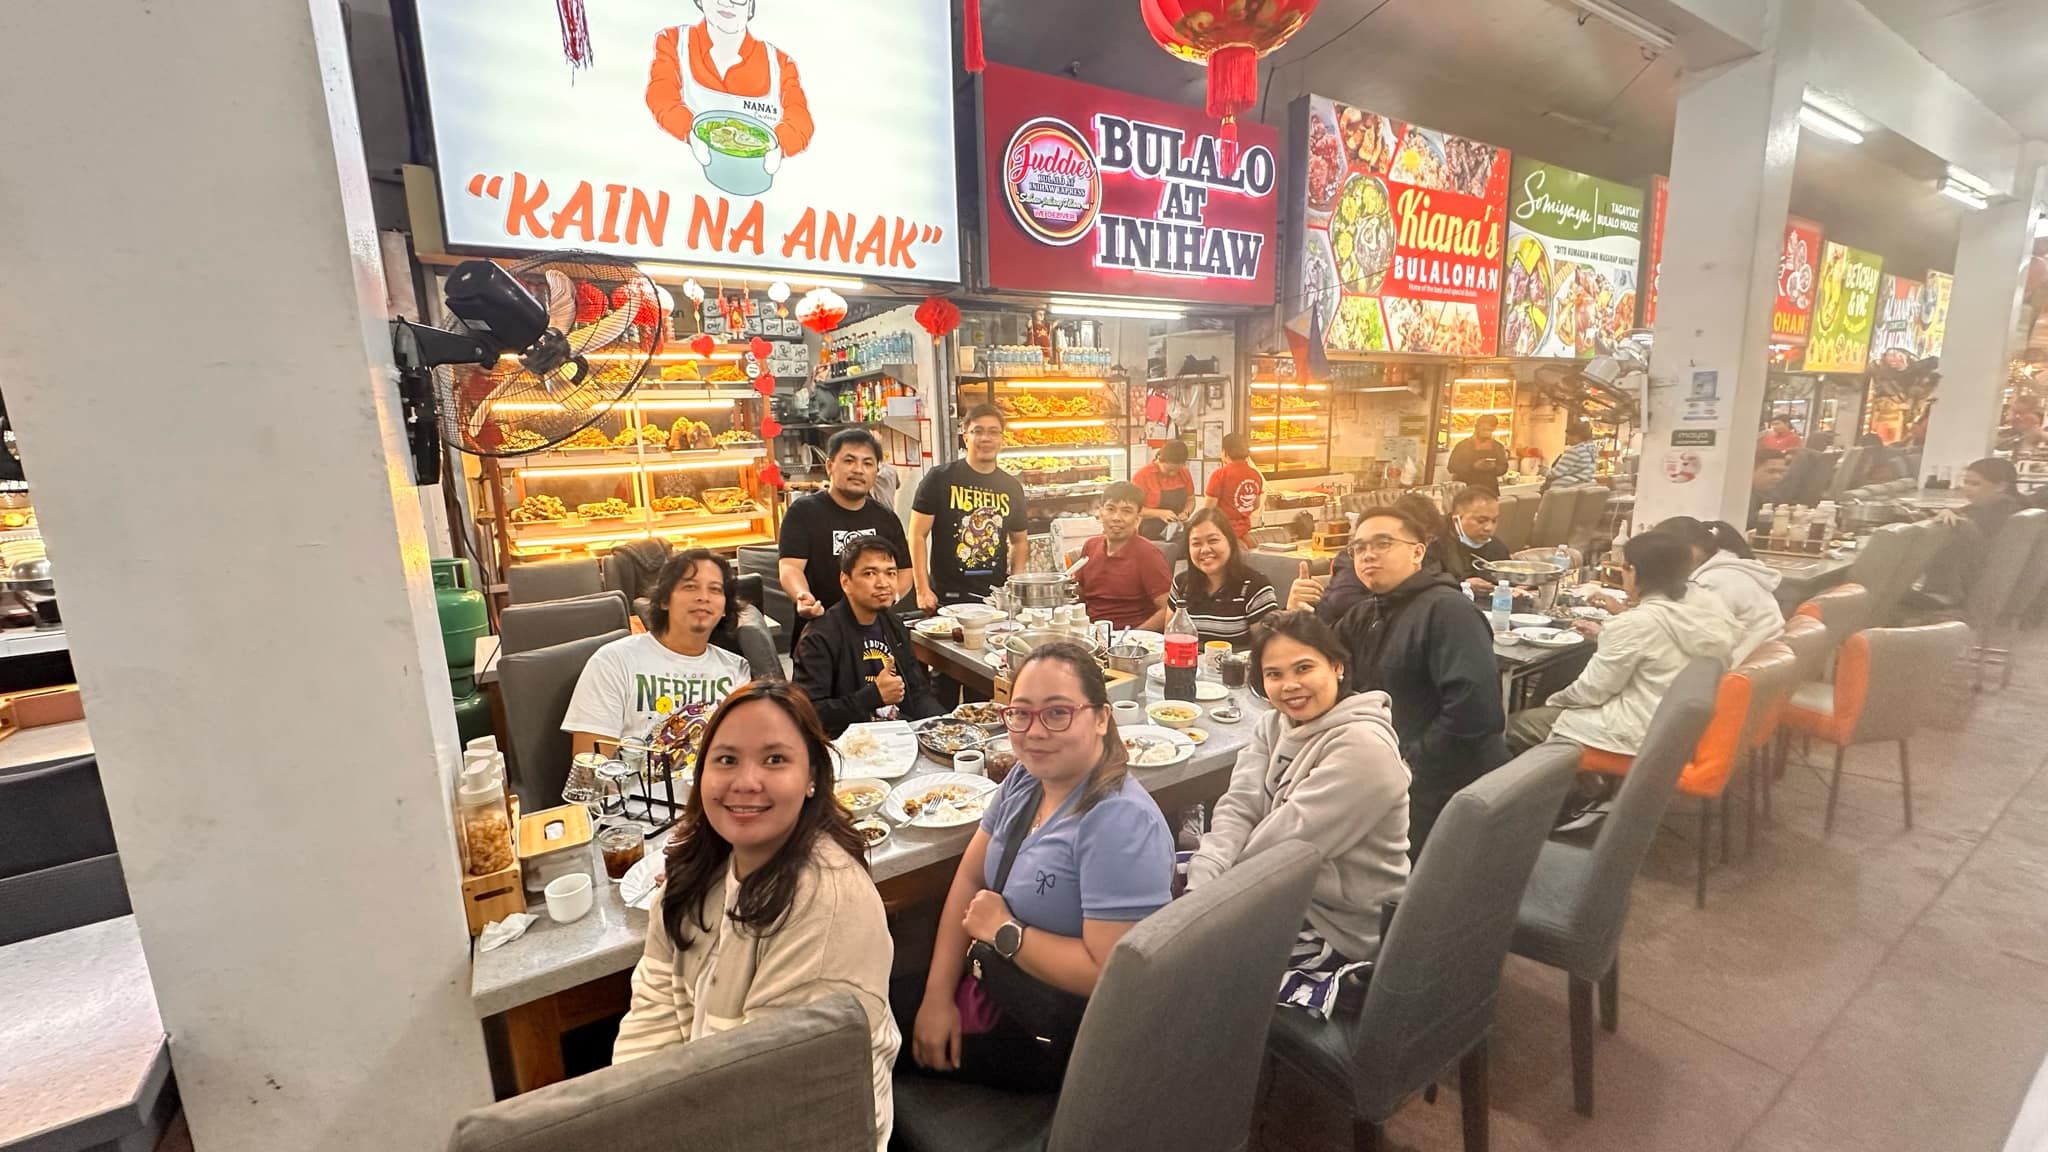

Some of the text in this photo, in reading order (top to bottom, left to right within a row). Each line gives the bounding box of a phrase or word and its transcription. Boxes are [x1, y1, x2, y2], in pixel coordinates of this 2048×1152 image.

[743, 100, 777, 114] NANA's
[1010, 142, 1095, 184] Juddies
[1056, 186, 1086, 197] EXPRESS
[1158, 182, 1208, 224] AT
[687, 194, 765, 255] NA
[1397, 188, 1499, 260] Kiana's
[1597, 214, 1639, 232] BULALO HOUSE
[1611, 202, 1640, 219] TAGAYTAY
[1094, 214, 1264, 279] INIHAW
[1394, 255, 1499, 292] BULALOHAN
[950, 485, 1010, 517] NEREUS
